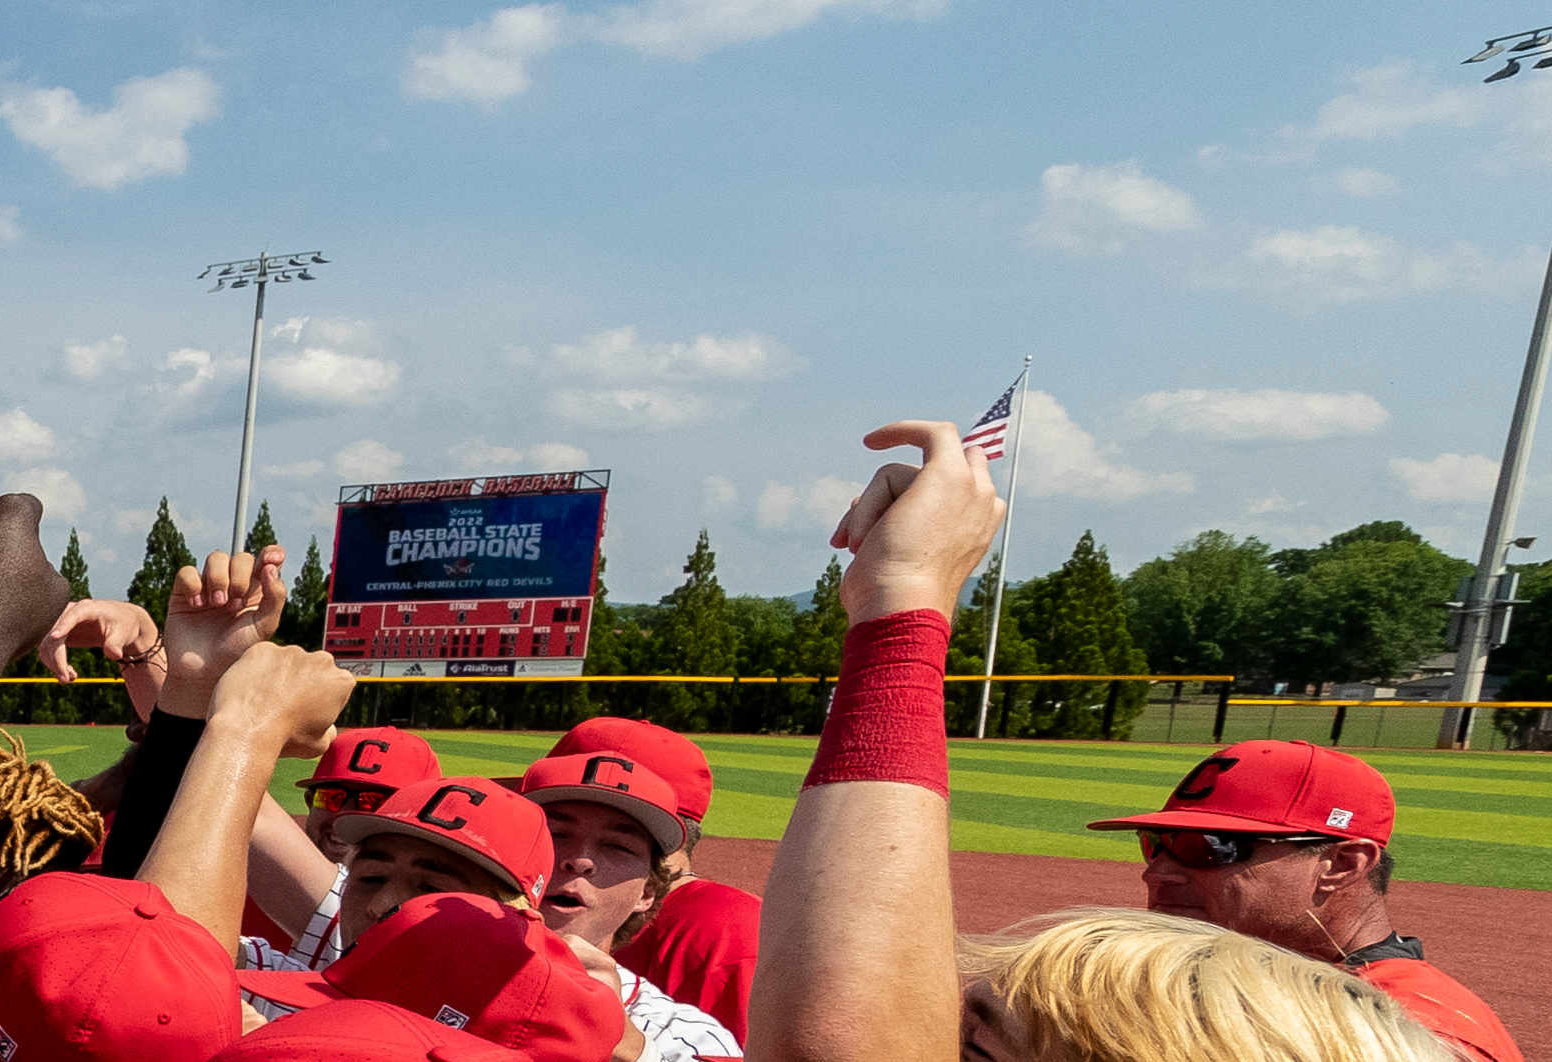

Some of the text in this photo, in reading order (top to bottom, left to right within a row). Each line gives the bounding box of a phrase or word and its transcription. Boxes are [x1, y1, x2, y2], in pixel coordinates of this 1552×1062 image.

[482, 472, 577, 495] BASEBALL
[388, 523, 543, 543] BASEBALL STATE
[448, 516, 484, 527] 2022
[385, 537, 542, 567] CHAMPIONS
[512, 576, 554, 587] DEVILS
[348, 739, 391, 774] C
[581, 756, 634, 792] C
[1175, 756, 1241, 801] C
[416, 784, 488, 831] C
